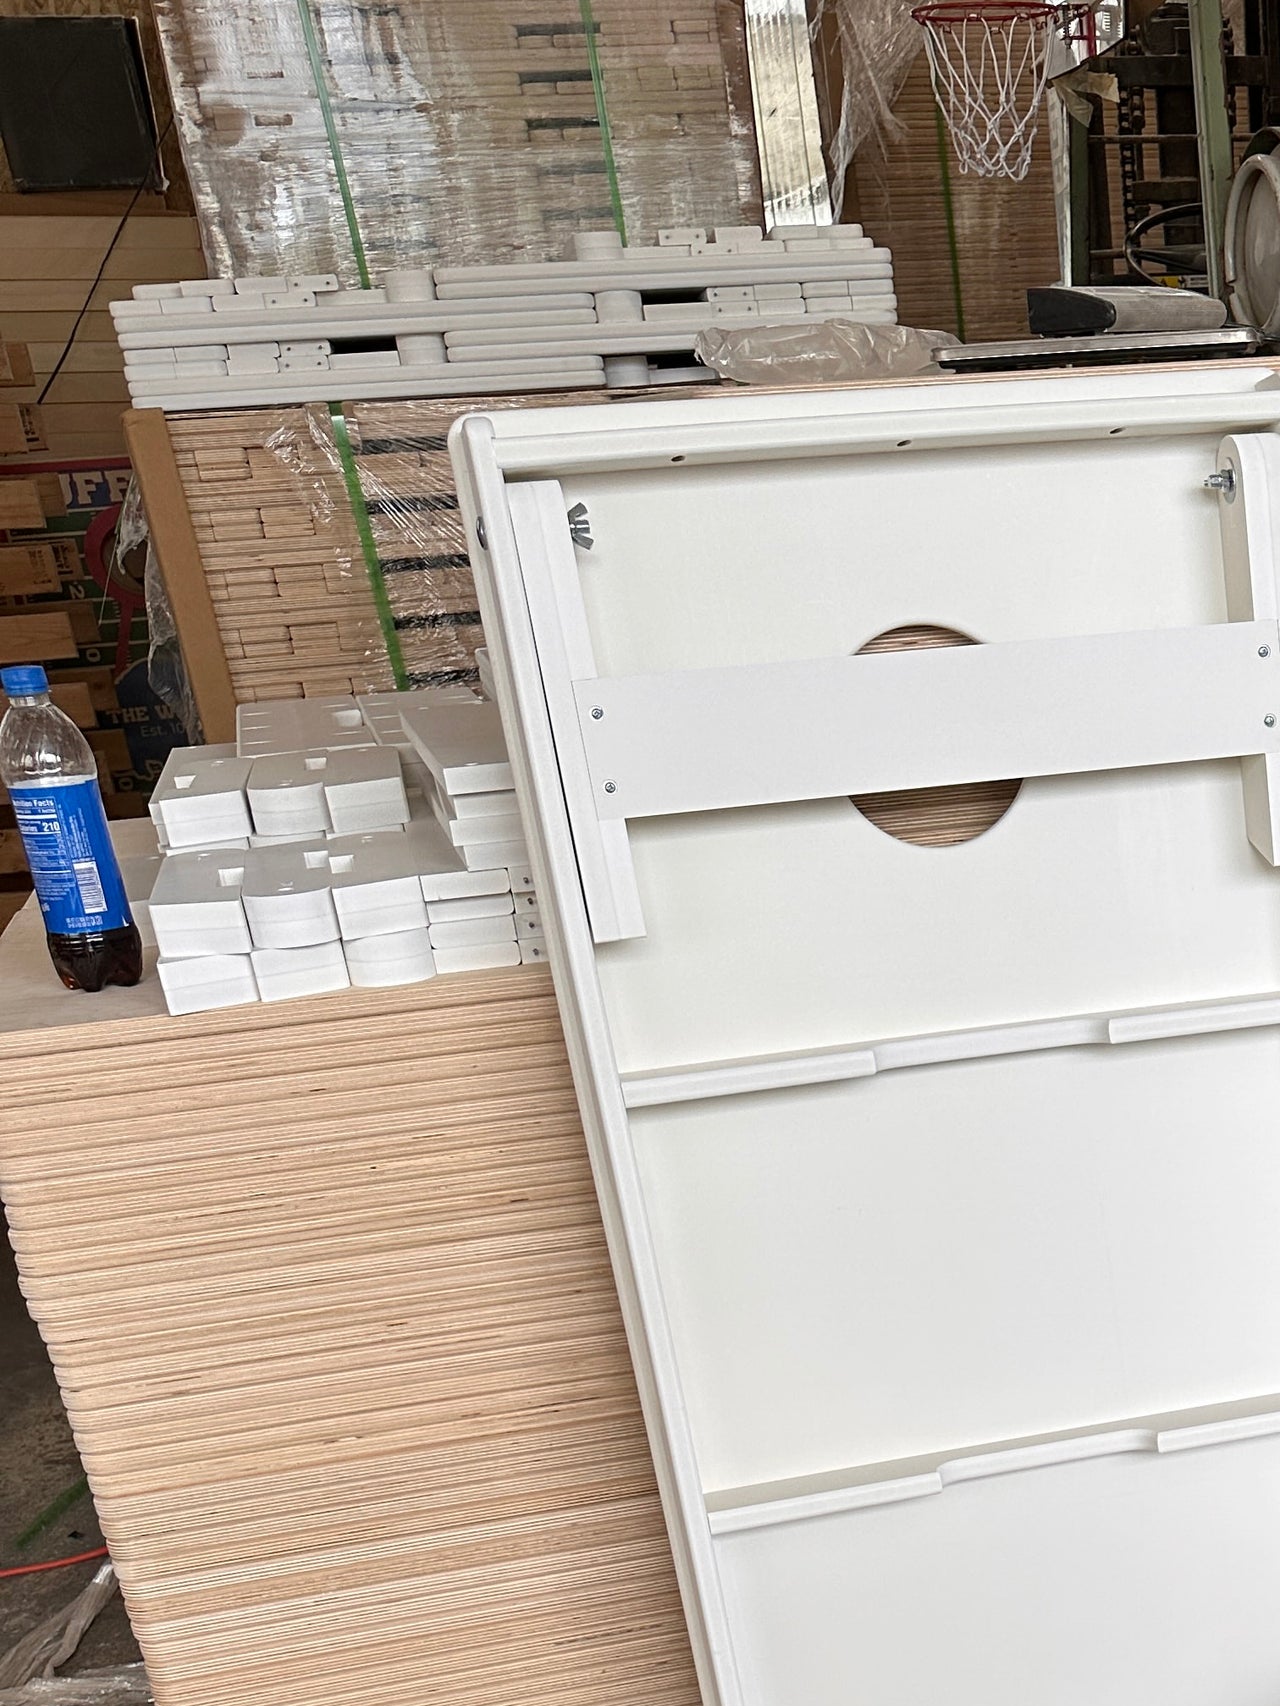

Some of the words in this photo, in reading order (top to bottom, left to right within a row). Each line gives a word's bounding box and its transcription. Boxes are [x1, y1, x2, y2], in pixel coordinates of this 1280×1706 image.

[106, 706, 150, 724] THE
[34, 799, 55, 807] Facts
[42, 822, 60, 832] 210
